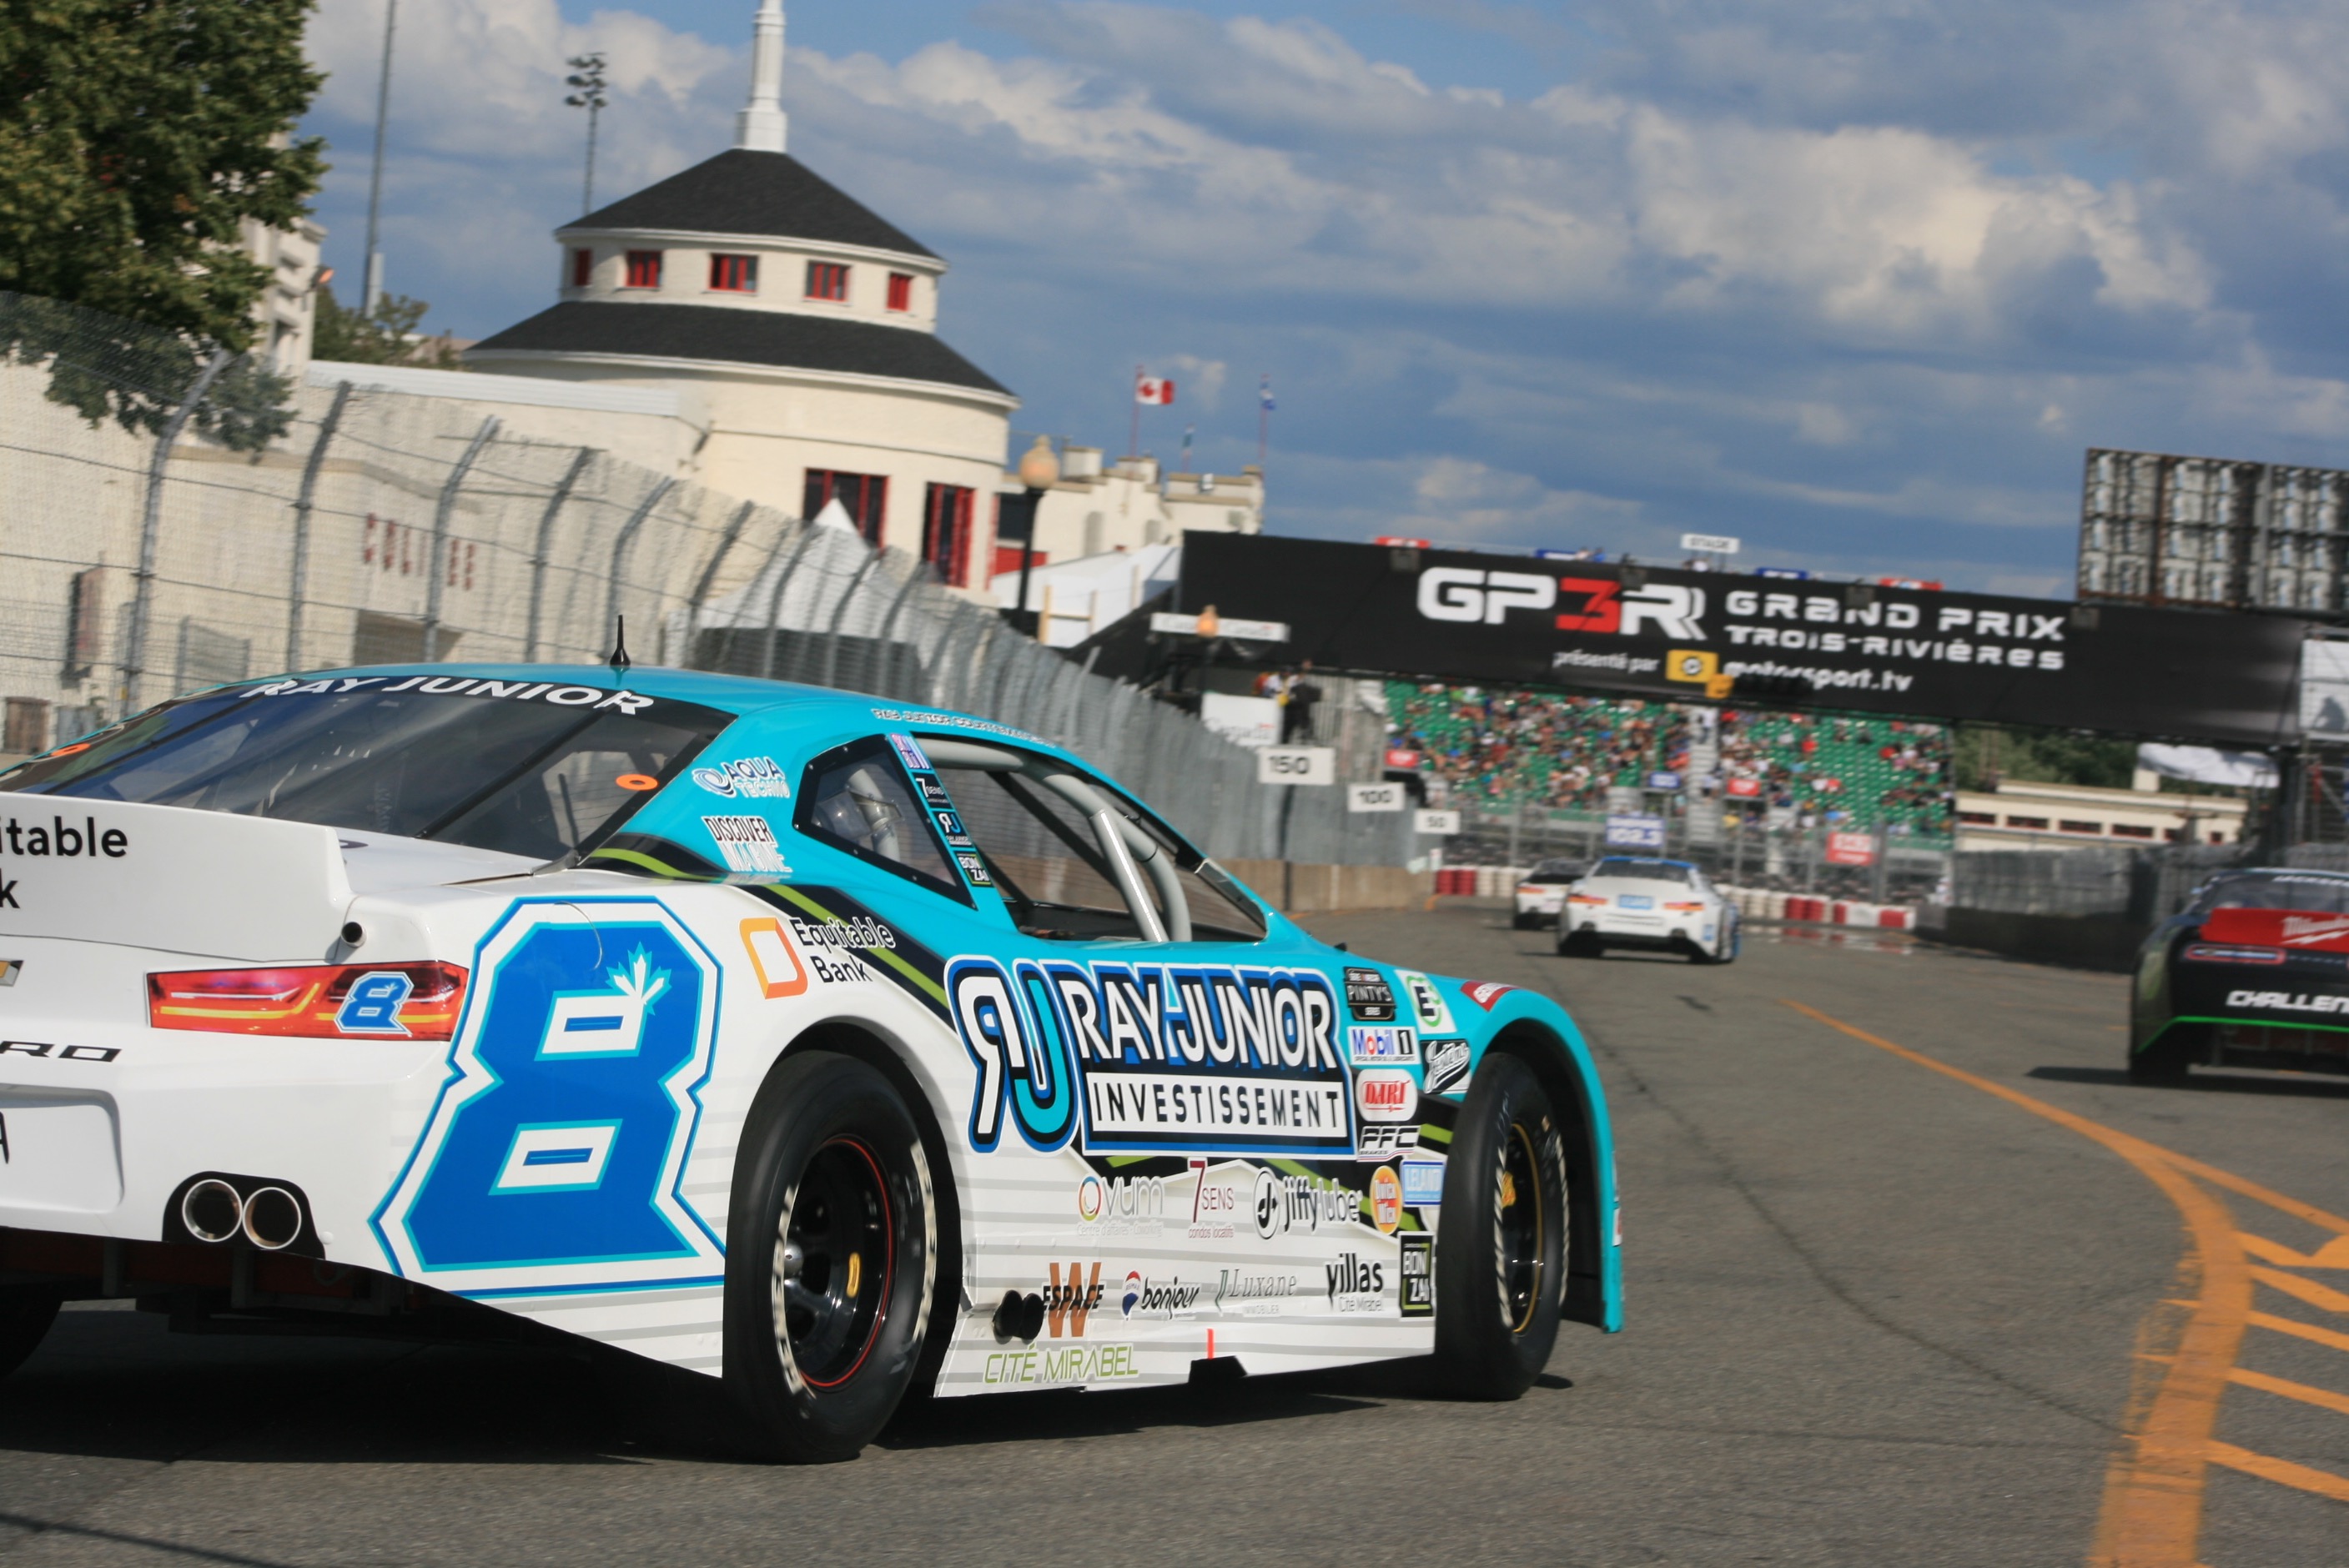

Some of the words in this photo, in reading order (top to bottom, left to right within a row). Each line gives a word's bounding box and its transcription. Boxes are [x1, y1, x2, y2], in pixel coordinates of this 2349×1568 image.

[1417, 565, 1707, 641] GP3R
[1725, 590, 1919, 629] GRAND
[1938, 607, 2065, 641] PRIX
[239, 677, 388, 698] RAY
[382, 676, 654, 716] JUNIOR
[722, 757, 785, 781] AQUA
[1269, 756, 1310, 774] 150
[915, 777, 929, 798] 7
[1359, 790, 1393, 804] 100
[703, 817, 775, 842] DISCOVER
[789, 917, 896, 953] Equitable
[810, 954, 873, 983] Bank
[334, 971, 415, 1036] 8
[1059, 979, 1165, 1061] RAY
[1175, 983, 1338, 1069] JUNIOR
[1352, 1028, 1395, 1055] Mobil
[1398, 1029, 1413, 1054] 1
[367, 896, 726, 1299] 8
[1093, 1082, 1340, 1128] INVESTISSEMENT
[1360, 1126, 1420, 1149] PFC
[1190, 1160, 1206, 1223] 7
[1201, 1187, 1235, 1210] SENS
[1188, 1224, 1212, 1239] condos
[1402, 1251, 1427, 1275] BON
[1043, 1284, 1104, 1311] ESPACE
[1140, 1275, 1200, 1320] bonjour
[1228, 1268, 1298, 1298] Luxane
[1325, 1253, 1384, 1311] villas
[984, 1344, 1038, 1384] CITÉ
[1043, 1345, 1139, 1381] MIRABEL
